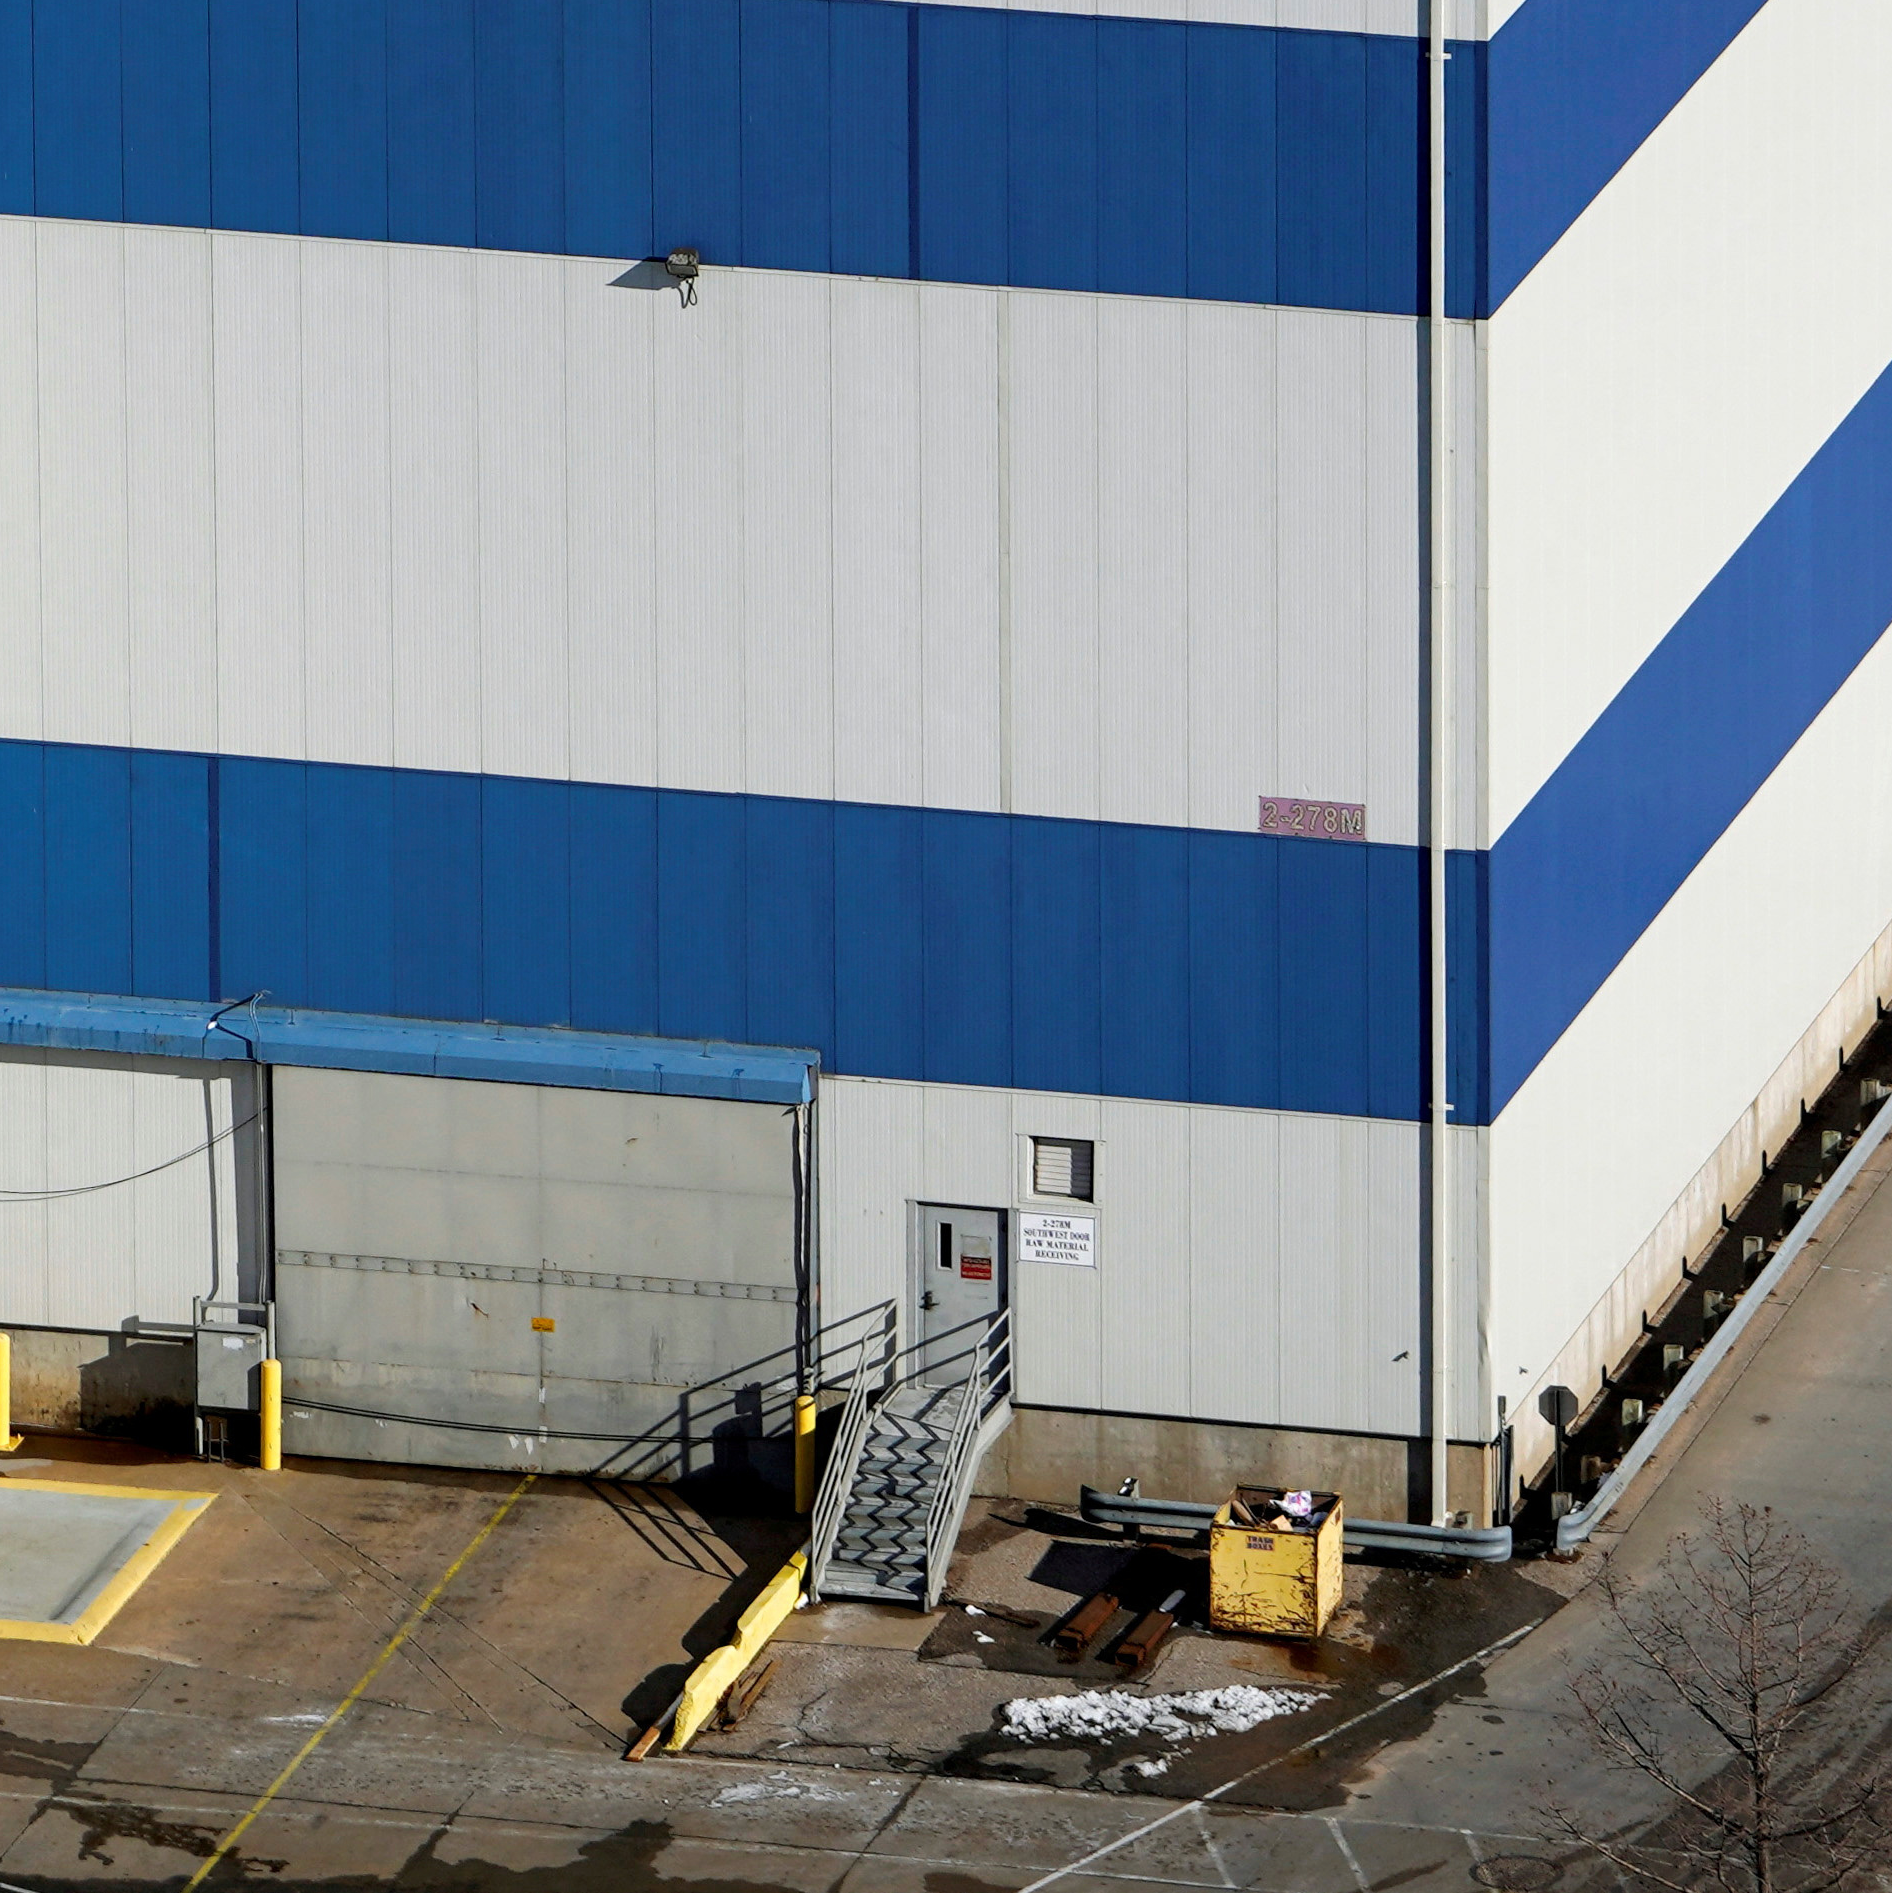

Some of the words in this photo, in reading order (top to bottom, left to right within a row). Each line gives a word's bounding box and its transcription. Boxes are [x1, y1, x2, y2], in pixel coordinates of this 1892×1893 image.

[1263, 802, 1362, 835] 2-278M
[1042, 1219, 1071, 1229] 2-278M
[1023, 1228, 1068, 1239] SOUTHWEST
[1070, 1232, 1090, 1241] DOOR
[1025, 1239, 1043, 1247] RAW
[1046, 1240, 1089, 1251] MATERIAL
[1034, 1249, 1079, 1260] RECEIVING
